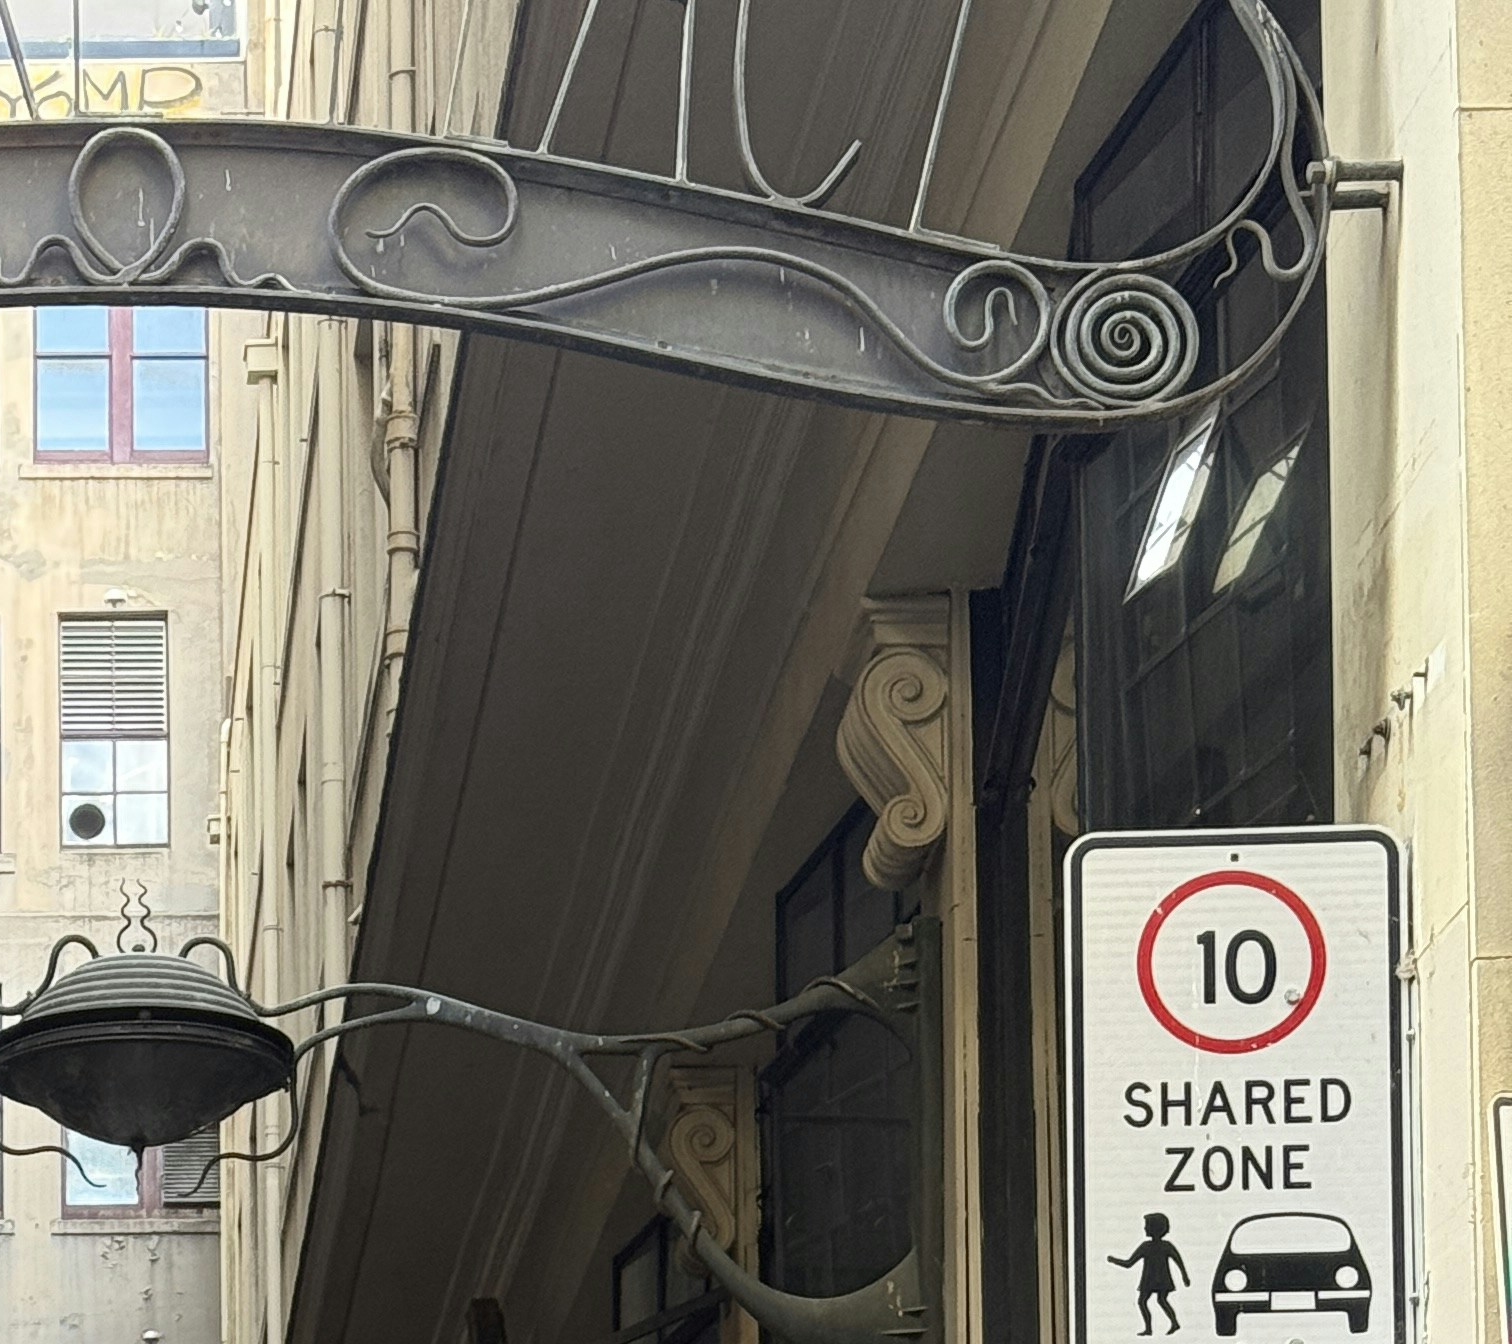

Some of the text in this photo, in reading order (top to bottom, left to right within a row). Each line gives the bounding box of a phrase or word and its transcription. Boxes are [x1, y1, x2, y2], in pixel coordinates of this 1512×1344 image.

[1197, 930, 1277, 1005] 10
[1123, 1078, 1352, 1128] SHARED
[1164, 1145, 1313, 1192] ZONE
